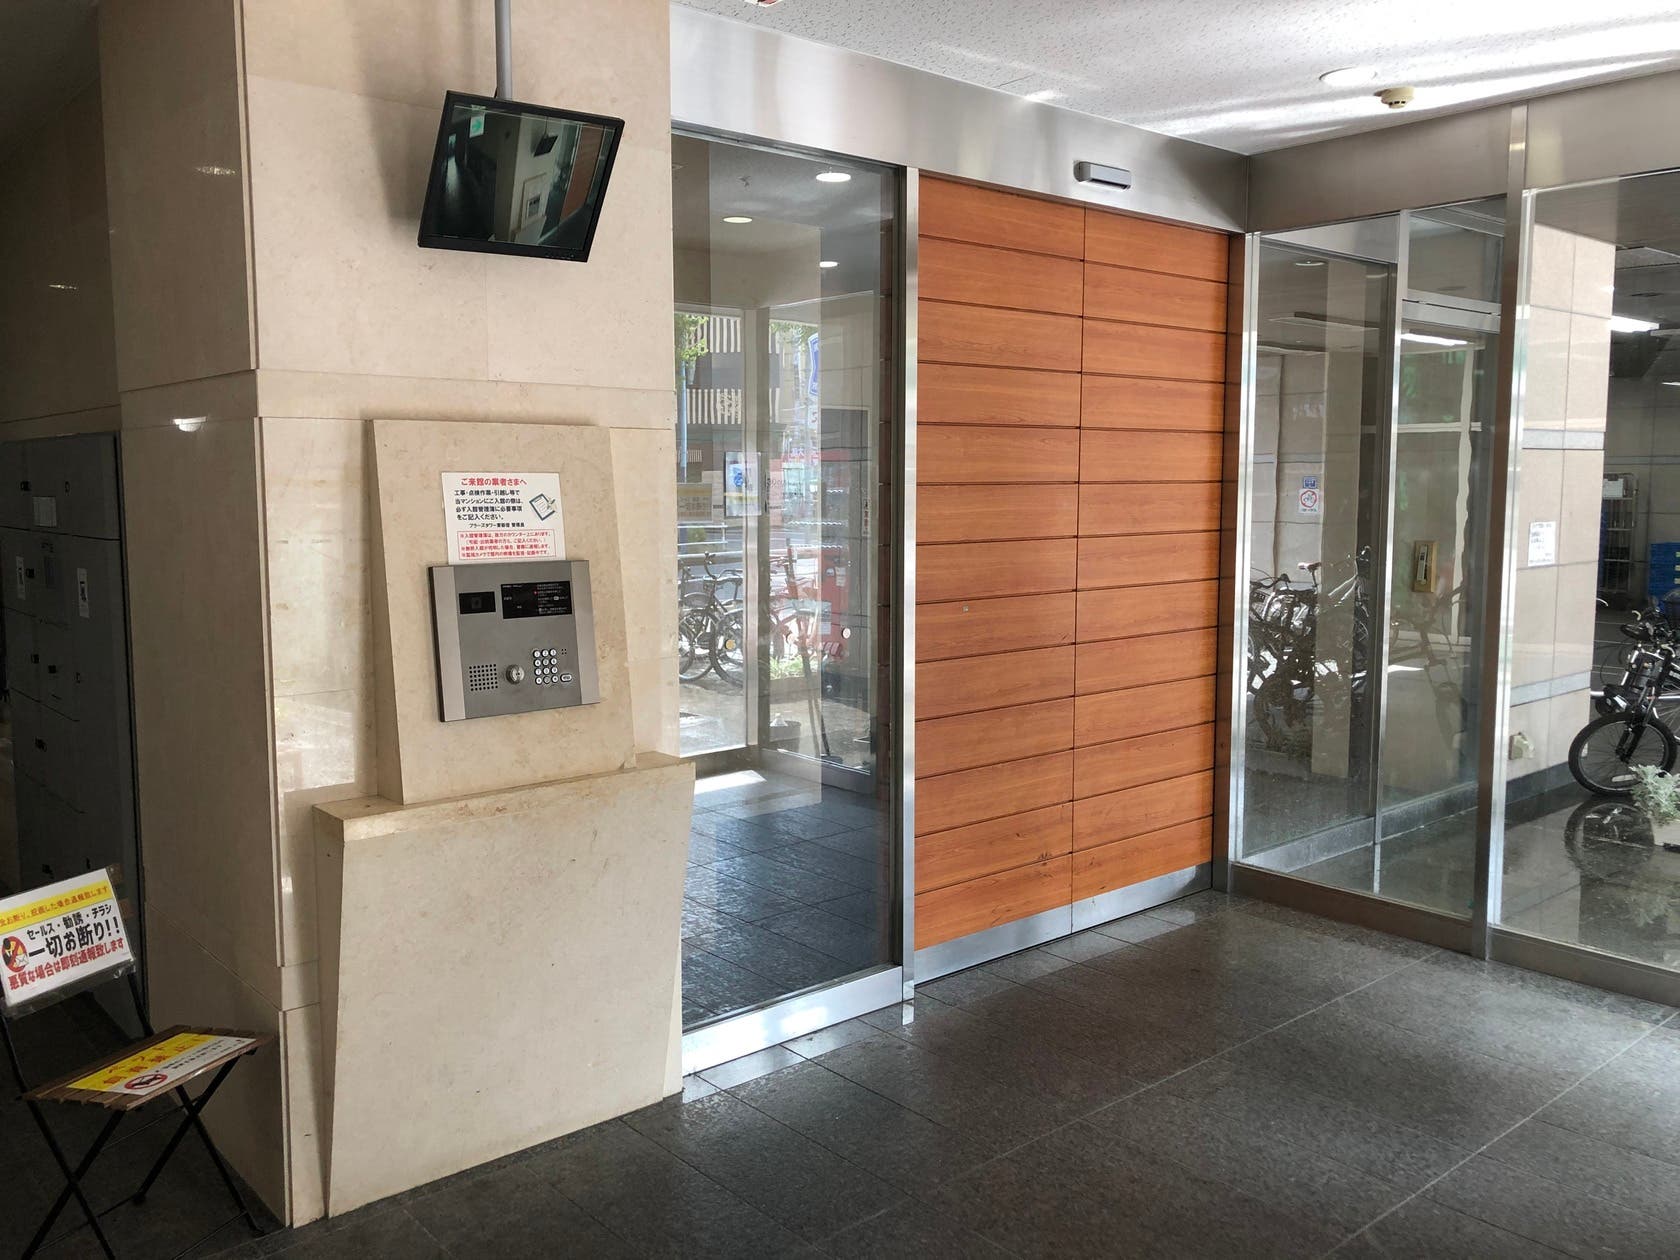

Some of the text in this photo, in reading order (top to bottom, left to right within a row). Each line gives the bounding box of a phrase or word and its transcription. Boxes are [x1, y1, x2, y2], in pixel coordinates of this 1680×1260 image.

[461, 478, 527, 486] ご来館の業者さまへ
[26, 903, 112, 941] セールス・勧誘・チラシ
[28, 916, 120, 959] 一切お断り!!
[8, 937, 124, 990] 悪質な場合は即刻通報致します
